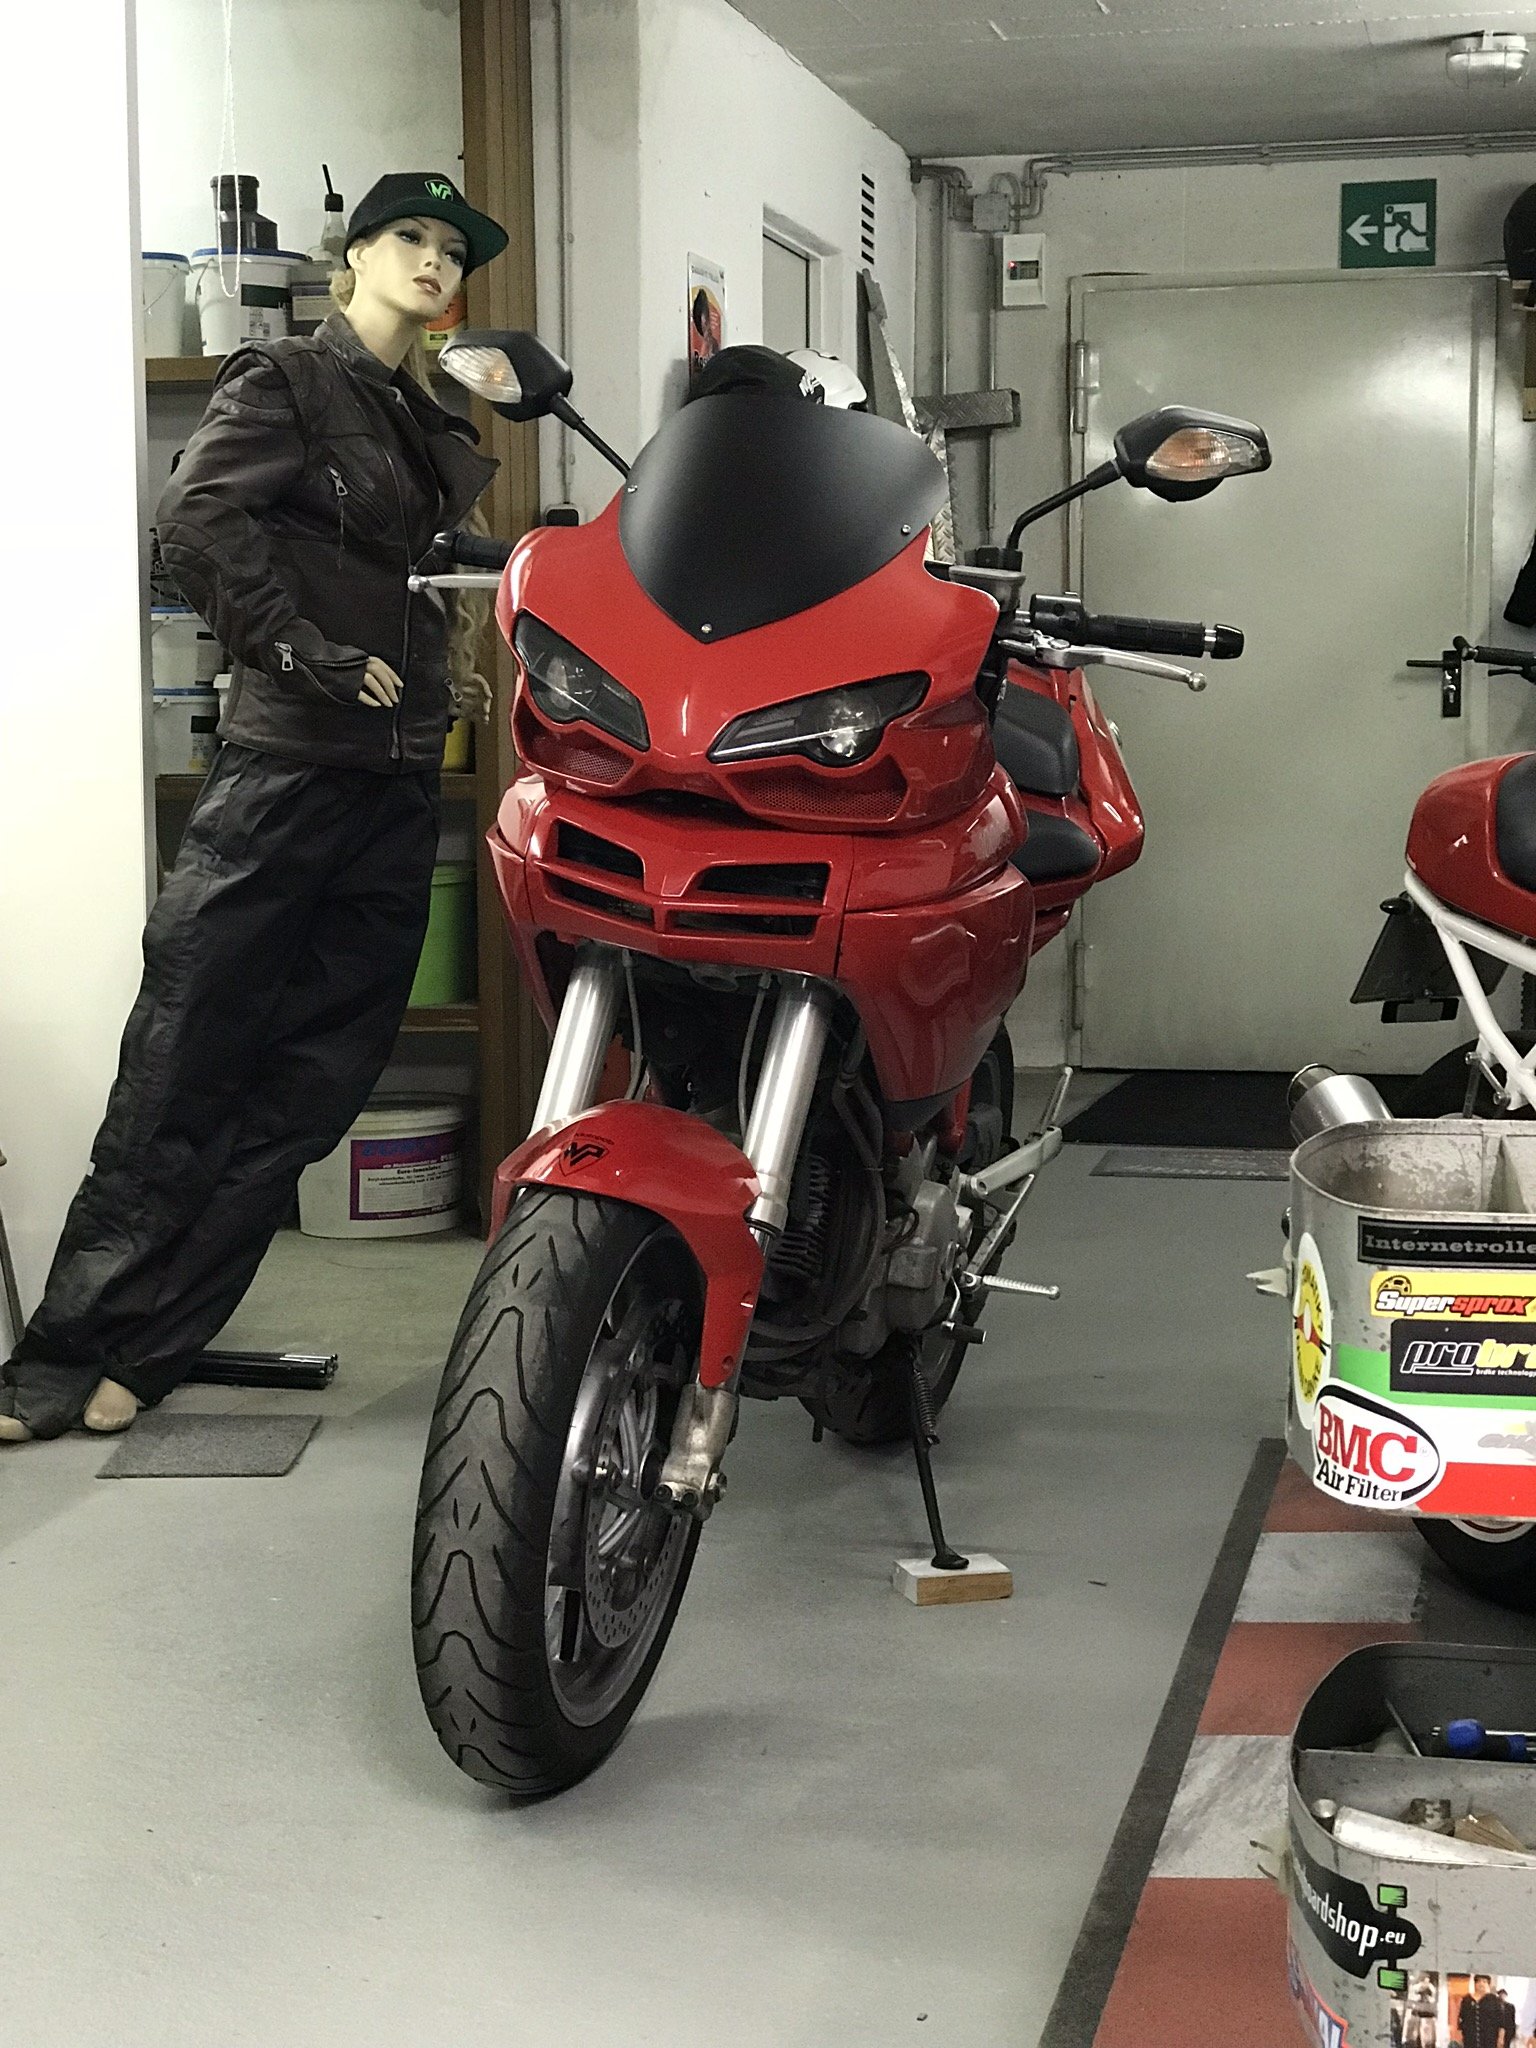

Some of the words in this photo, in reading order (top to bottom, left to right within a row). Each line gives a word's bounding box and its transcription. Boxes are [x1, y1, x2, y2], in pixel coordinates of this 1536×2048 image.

[1376, 1289, 1533, 1318] Supersprox
[1318, 1402, 1418, 1482] BMC
[1316, 1458, 1344, 1491] Air
[1345, 1474, 1400, 1501] Filter
